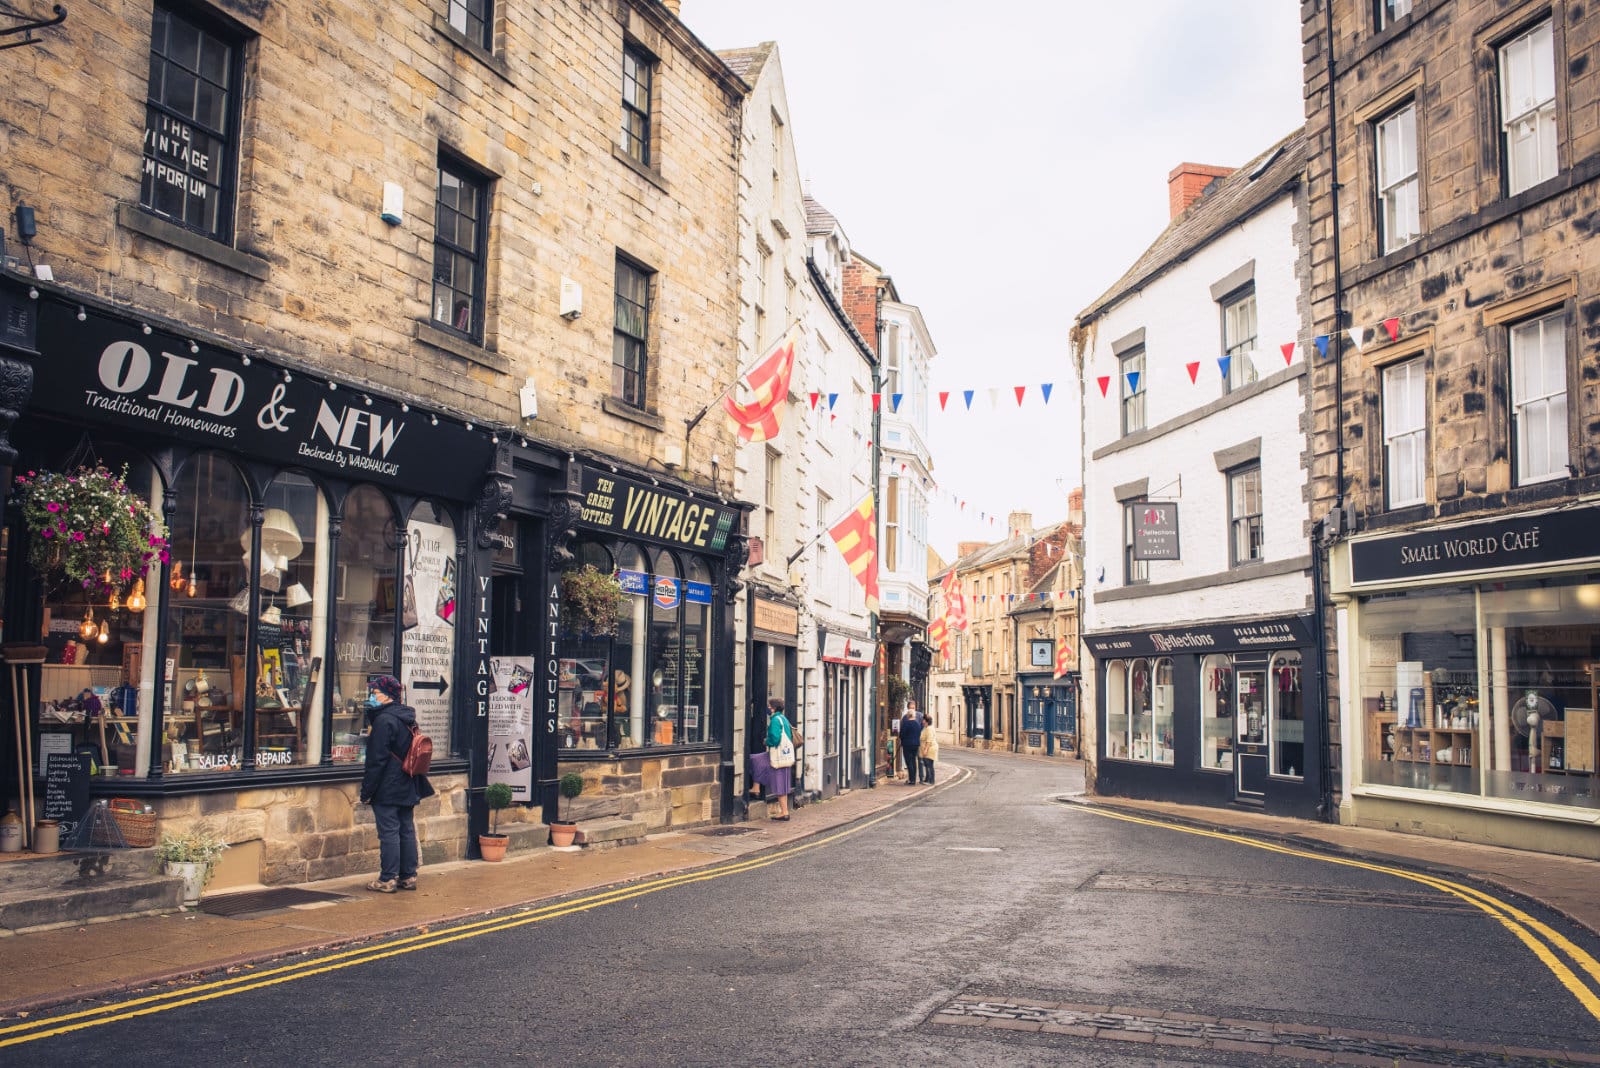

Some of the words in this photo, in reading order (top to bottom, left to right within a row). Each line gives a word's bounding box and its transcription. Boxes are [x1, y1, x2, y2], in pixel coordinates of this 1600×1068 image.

[161, 114, 190, 141] THE
[142, 157, 206, 199] MPORIUM
[85, 390, 162, 421] Traditional
[164, 409, 238, 438] Homewares
[98, 340, 245, 417] OLD
[257, 383, 296, 432] &
[311, 398, 406, 460] NEW
[336, 450, 348, 468] By
[597, 477, 615, 493] TEN
[586, 492, 615, 510] GREEN
[581, 507, 614, 526] OTTLES
[622, 486, 716, 547] VINTAGE
[1401, 546, 1441, 565] SMALL
[1443, 536, 1498, 558] WORLD
[477, 575, 490, 717] VINTAGE
[1149, 632, 1215, 651] Reflections
[548, 584, 559, 733] ANTIQUES
[199, 752, 229, 769] SALES
[230, 754, 239, 767] &
[256, 751, 292, 766] REPAIRS
